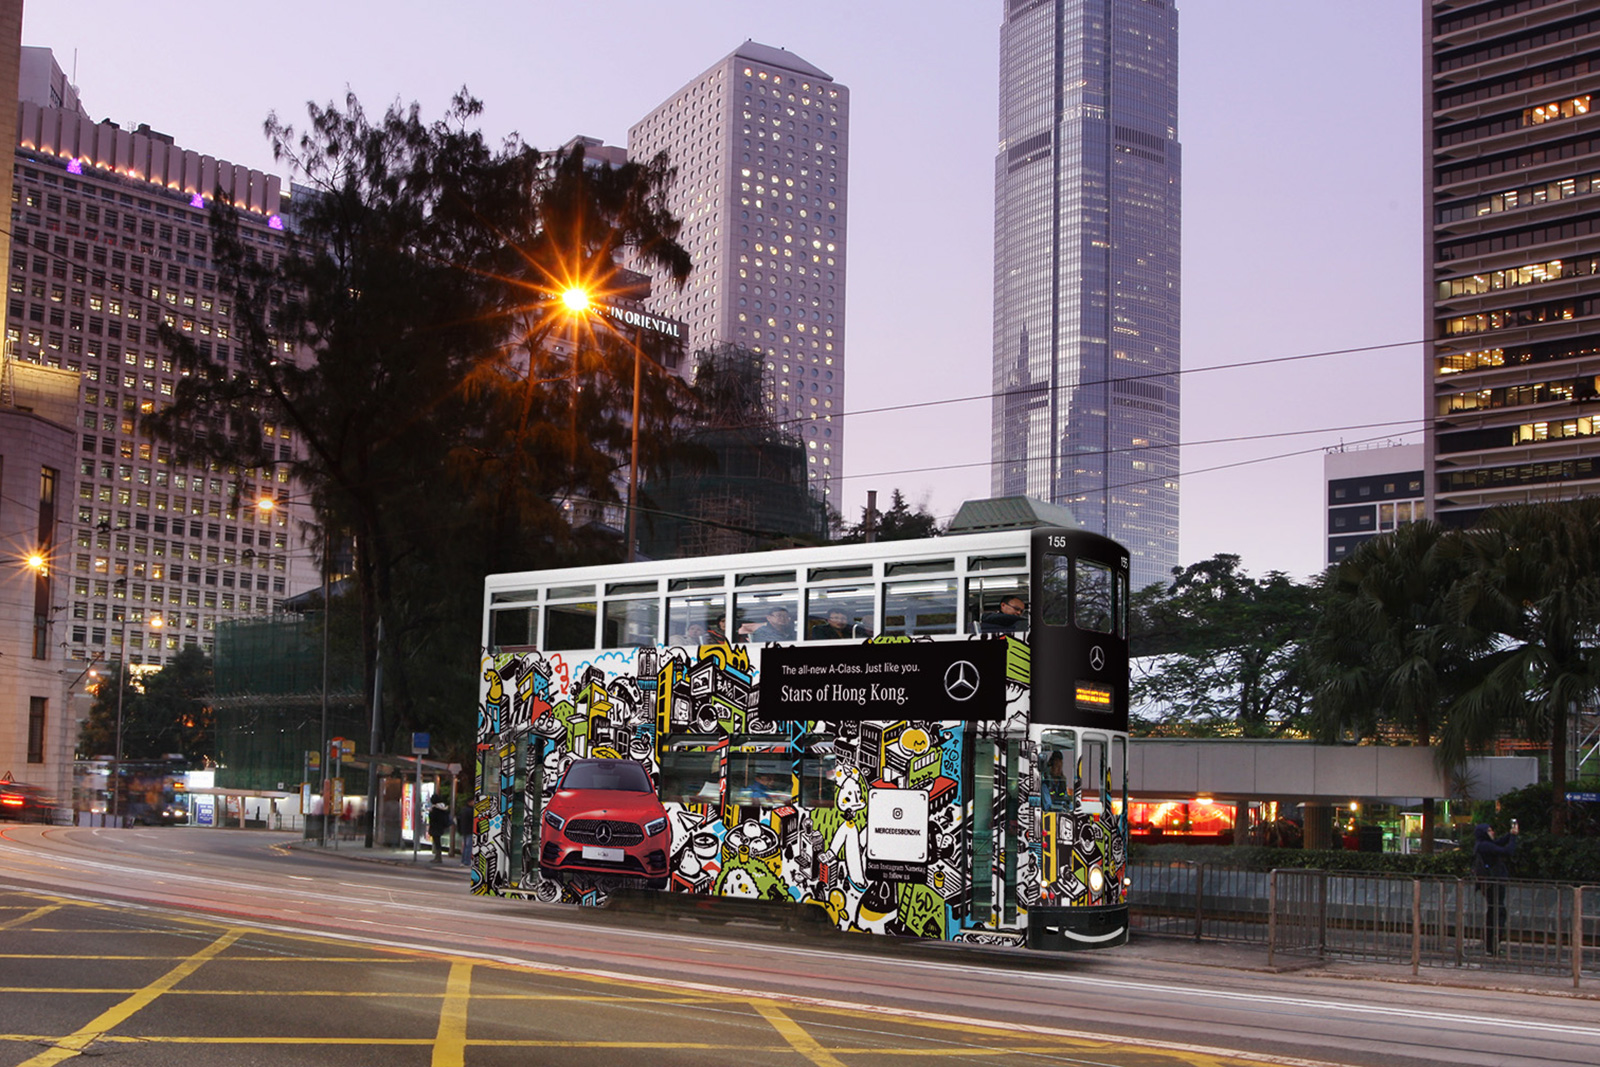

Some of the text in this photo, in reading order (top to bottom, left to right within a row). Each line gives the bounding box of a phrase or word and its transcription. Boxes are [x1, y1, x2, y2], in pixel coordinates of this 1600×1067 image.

[625, 310, 679, 337] ORIENTAL
[1048, 536, 1066, 548] 155
[782, 662, 921, 675] The all-new A-Class. Just like you.
[781, 683, 909, 706] Stars of Hong Kong.
[880, 862, 904, 872] Instagram
